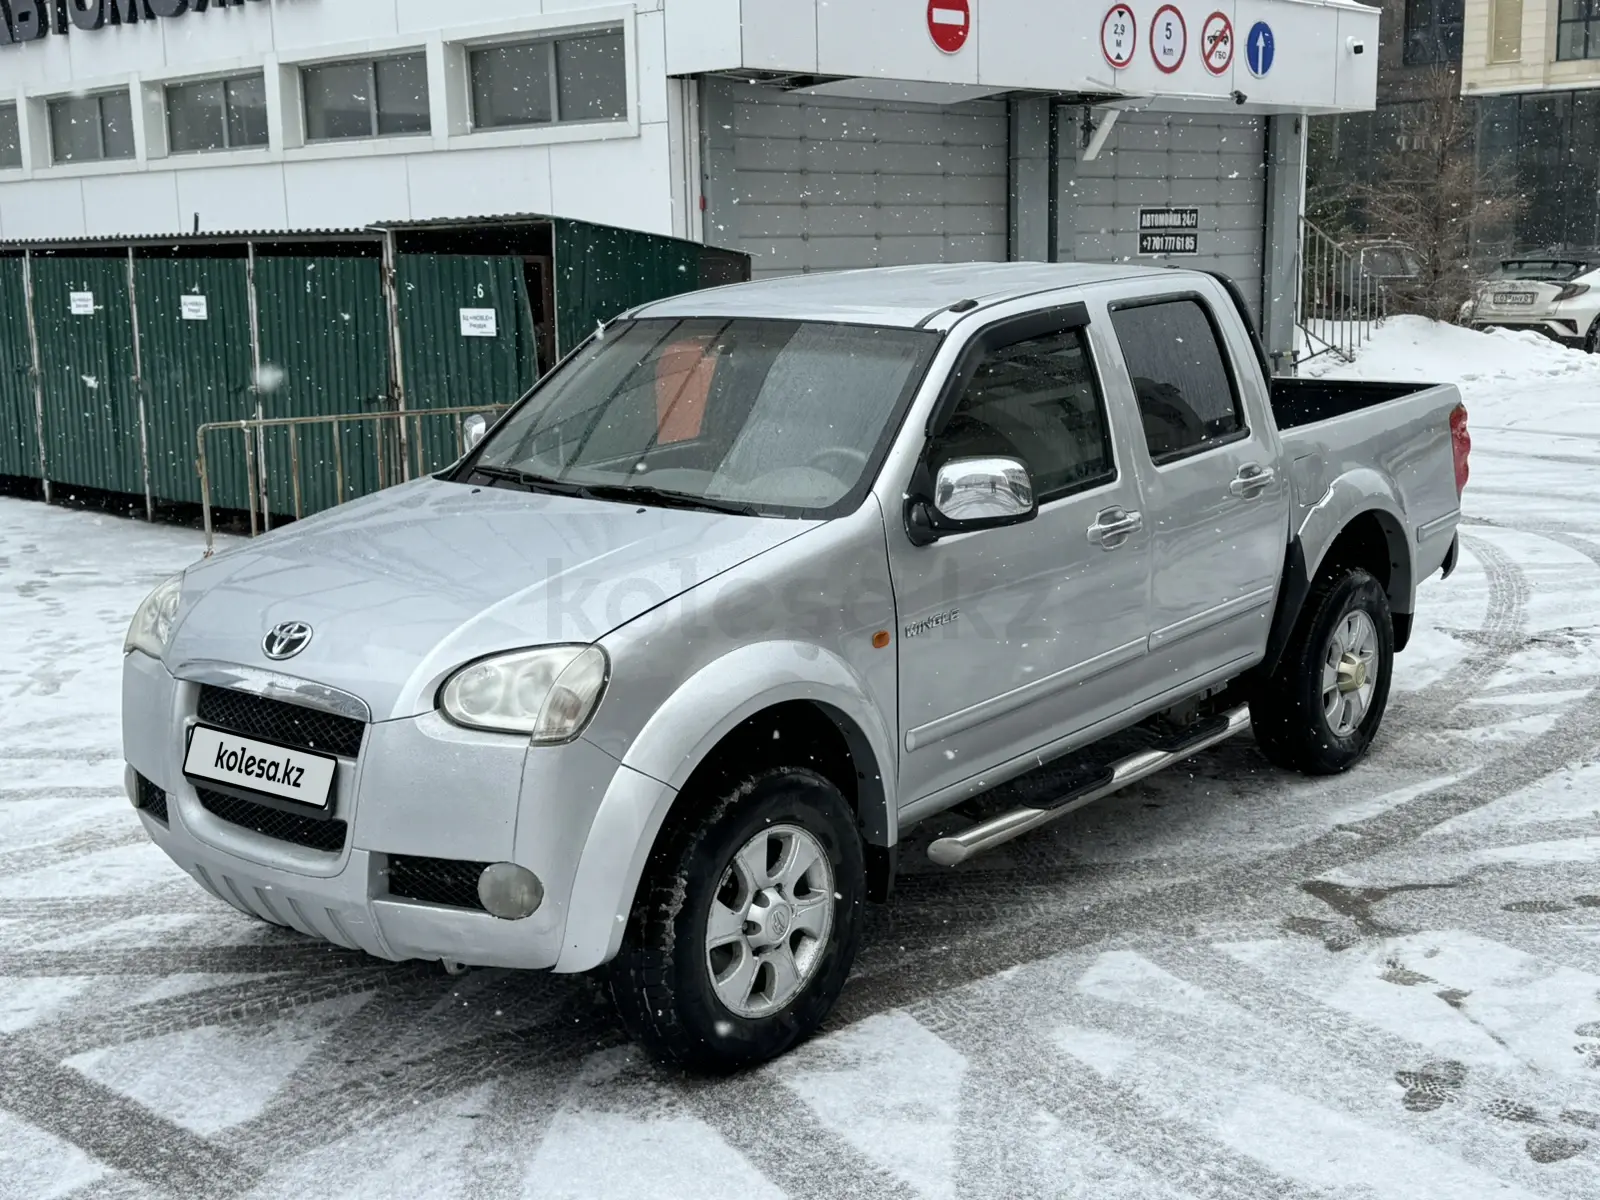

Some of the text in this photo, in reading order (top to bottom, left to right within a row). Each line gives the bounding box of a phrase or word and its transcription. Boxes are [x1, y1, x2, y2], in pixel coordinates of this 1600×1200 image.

[1113, 23, 1126, 37] 2,9
[1165, 22, 1172, 40] 5
[1162, 45, 1174, 56] km
[1142, 211, 1197, 227] АВТОМОЙКА 24/7
[477, 283, 484, 298] 6
[904, 608, 960, 639] WINGLE
